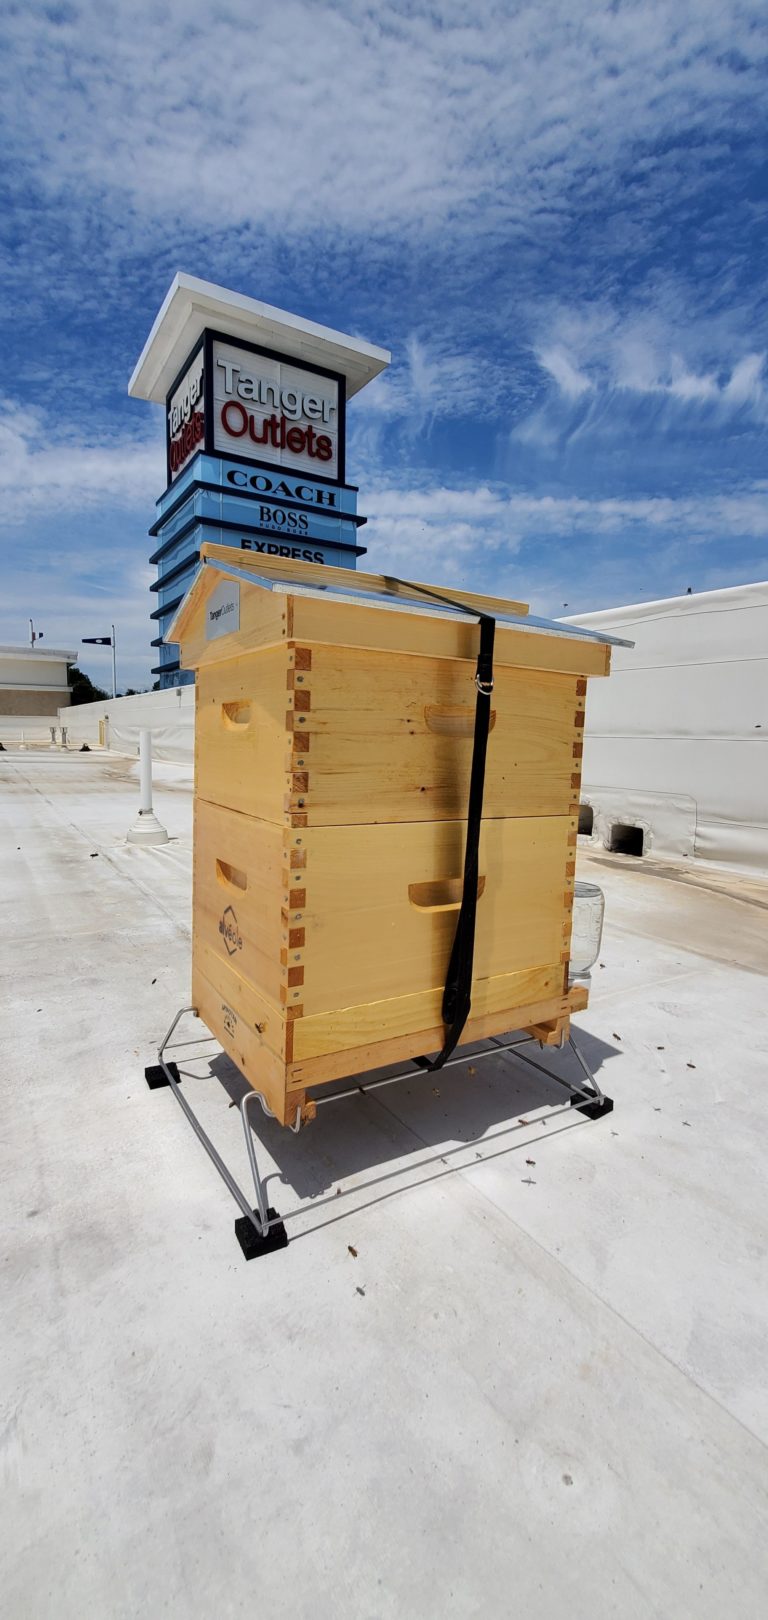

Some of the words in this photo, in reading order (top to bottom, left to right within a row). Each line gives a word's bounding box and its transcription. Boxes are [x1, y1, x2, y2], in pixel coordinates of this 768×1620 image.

[168, 369, 203, 438] Tanger
[217, 360, 335, 423] Tanger
[170, 412, 204, 471] Outlets
[221, 401, 333, 461] Outlets
[227, 470, 336, 507] COACH
[259, 506, 309, 529] BOSS
[241, 539, 324, 564] EXPRESS
